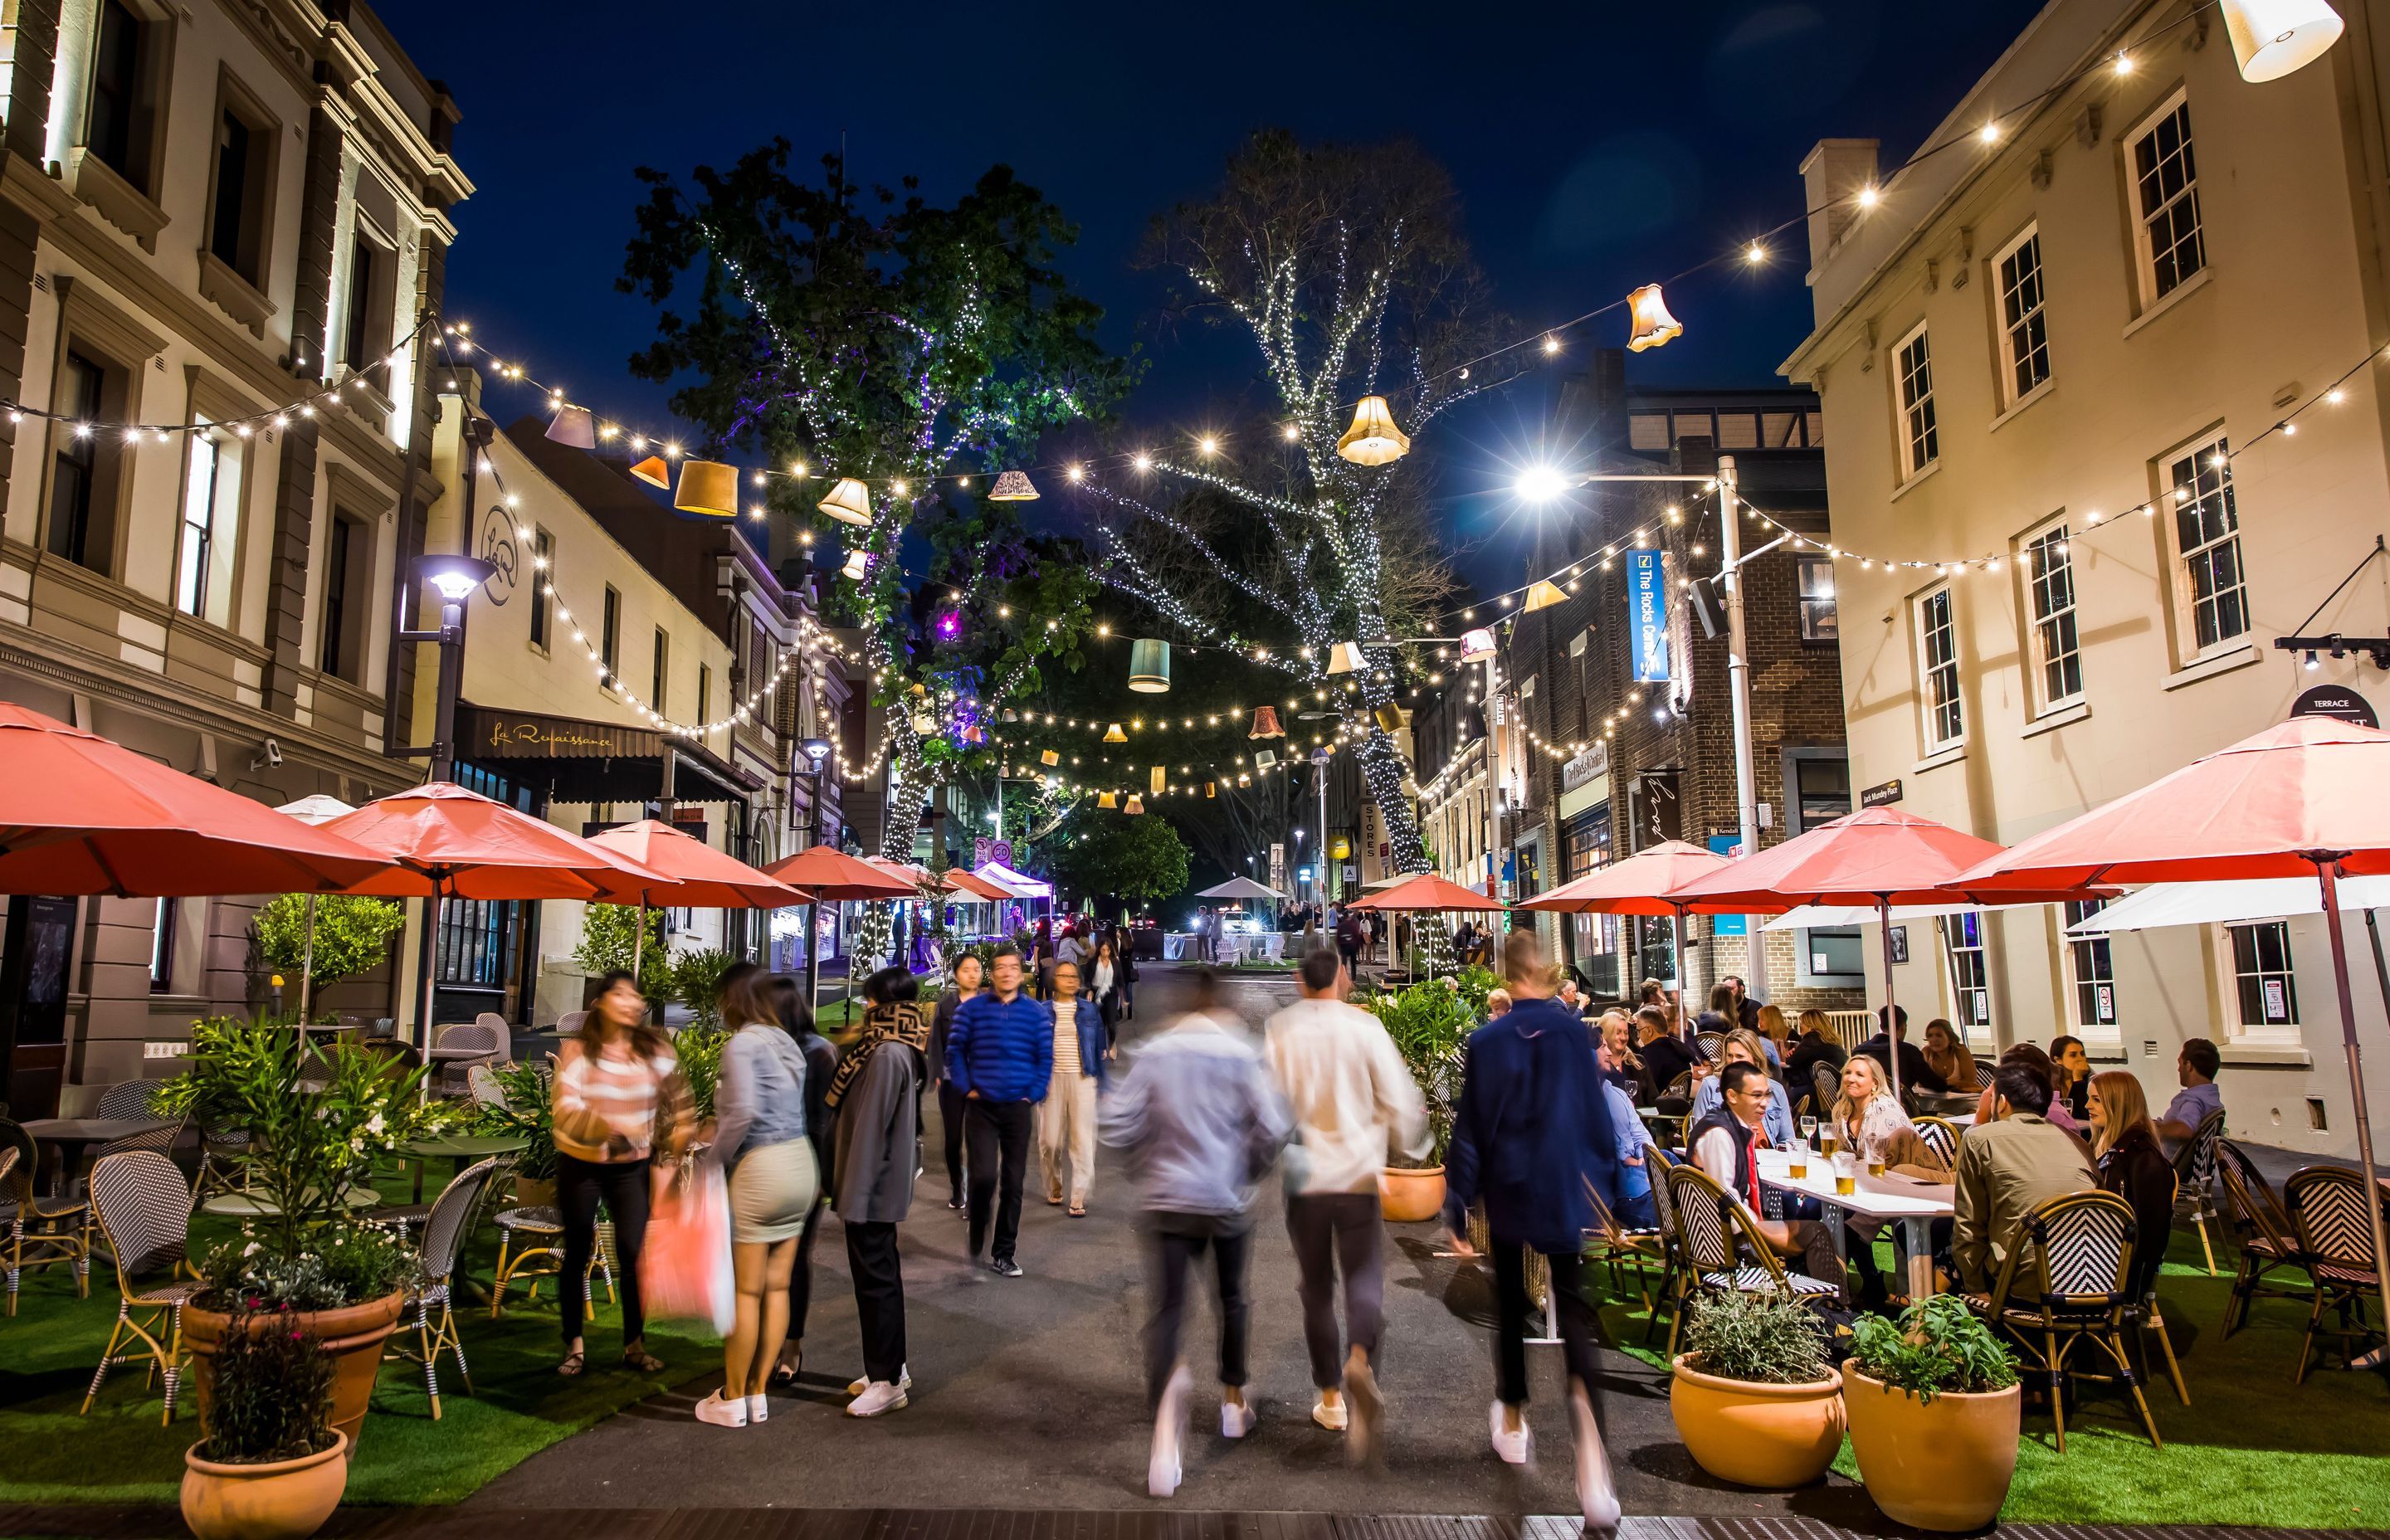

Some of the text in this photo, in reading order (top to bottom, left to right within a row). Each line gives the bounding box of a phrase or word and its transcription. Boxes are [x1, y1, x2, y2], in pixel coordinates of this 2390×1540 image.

[1639, 569, 1653, 589] The
[1641, 591, 1656, 623] Rocks
[2314, 699, 2349, 708] TERRACE
[490, 722, 613, 746] La Renaissance
[1576, 760, 1587, 778] Rocks
[1863, 787, 1898, 803] Jack Mundey Place
[1647, 778, 1675, 841] pony
[1366, 807, 1374, 856] STORES
[996, 848, 1007, 856] 50
